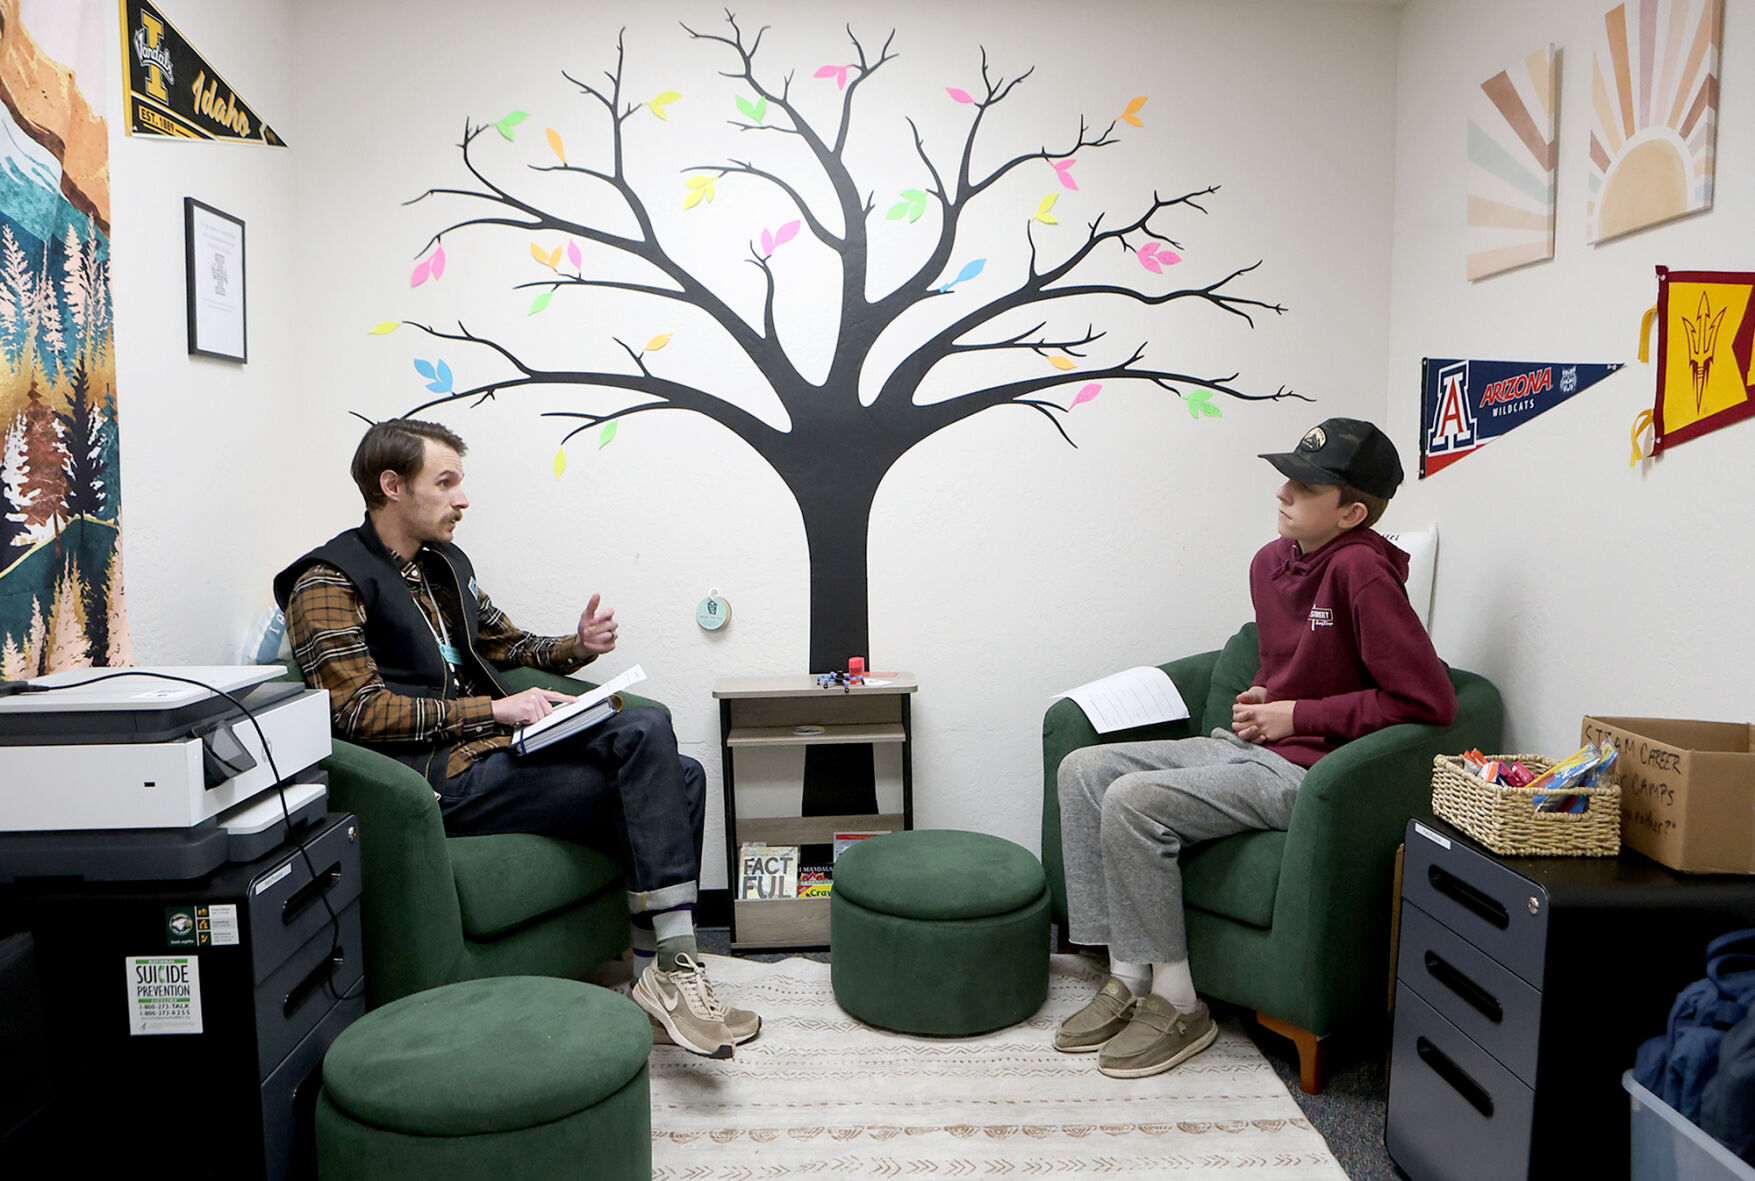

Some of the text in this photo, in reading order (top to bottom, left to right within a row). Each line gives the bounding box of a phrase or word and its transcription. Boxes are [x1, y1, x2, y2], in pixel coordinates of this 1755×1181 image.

[133, 27, 175, 85] Vandals
[192, 69, 251, 138] Idaho
[1479, 366, 1552, 408] ARIZONA
[1427, 359, 1478, 457] A
[1492, 398, 1535, 417] WILDCATS
[1640, 742, 1681, 774] CAREER
[1631, 773, 1675, 806] CAMPS
[743, 856, 793, 875] FACT
[742, 875, 791, 899] FUL
[136, 965, 189, 984] SUICIDE
[137, 985, 190, 997] PREVENTION
